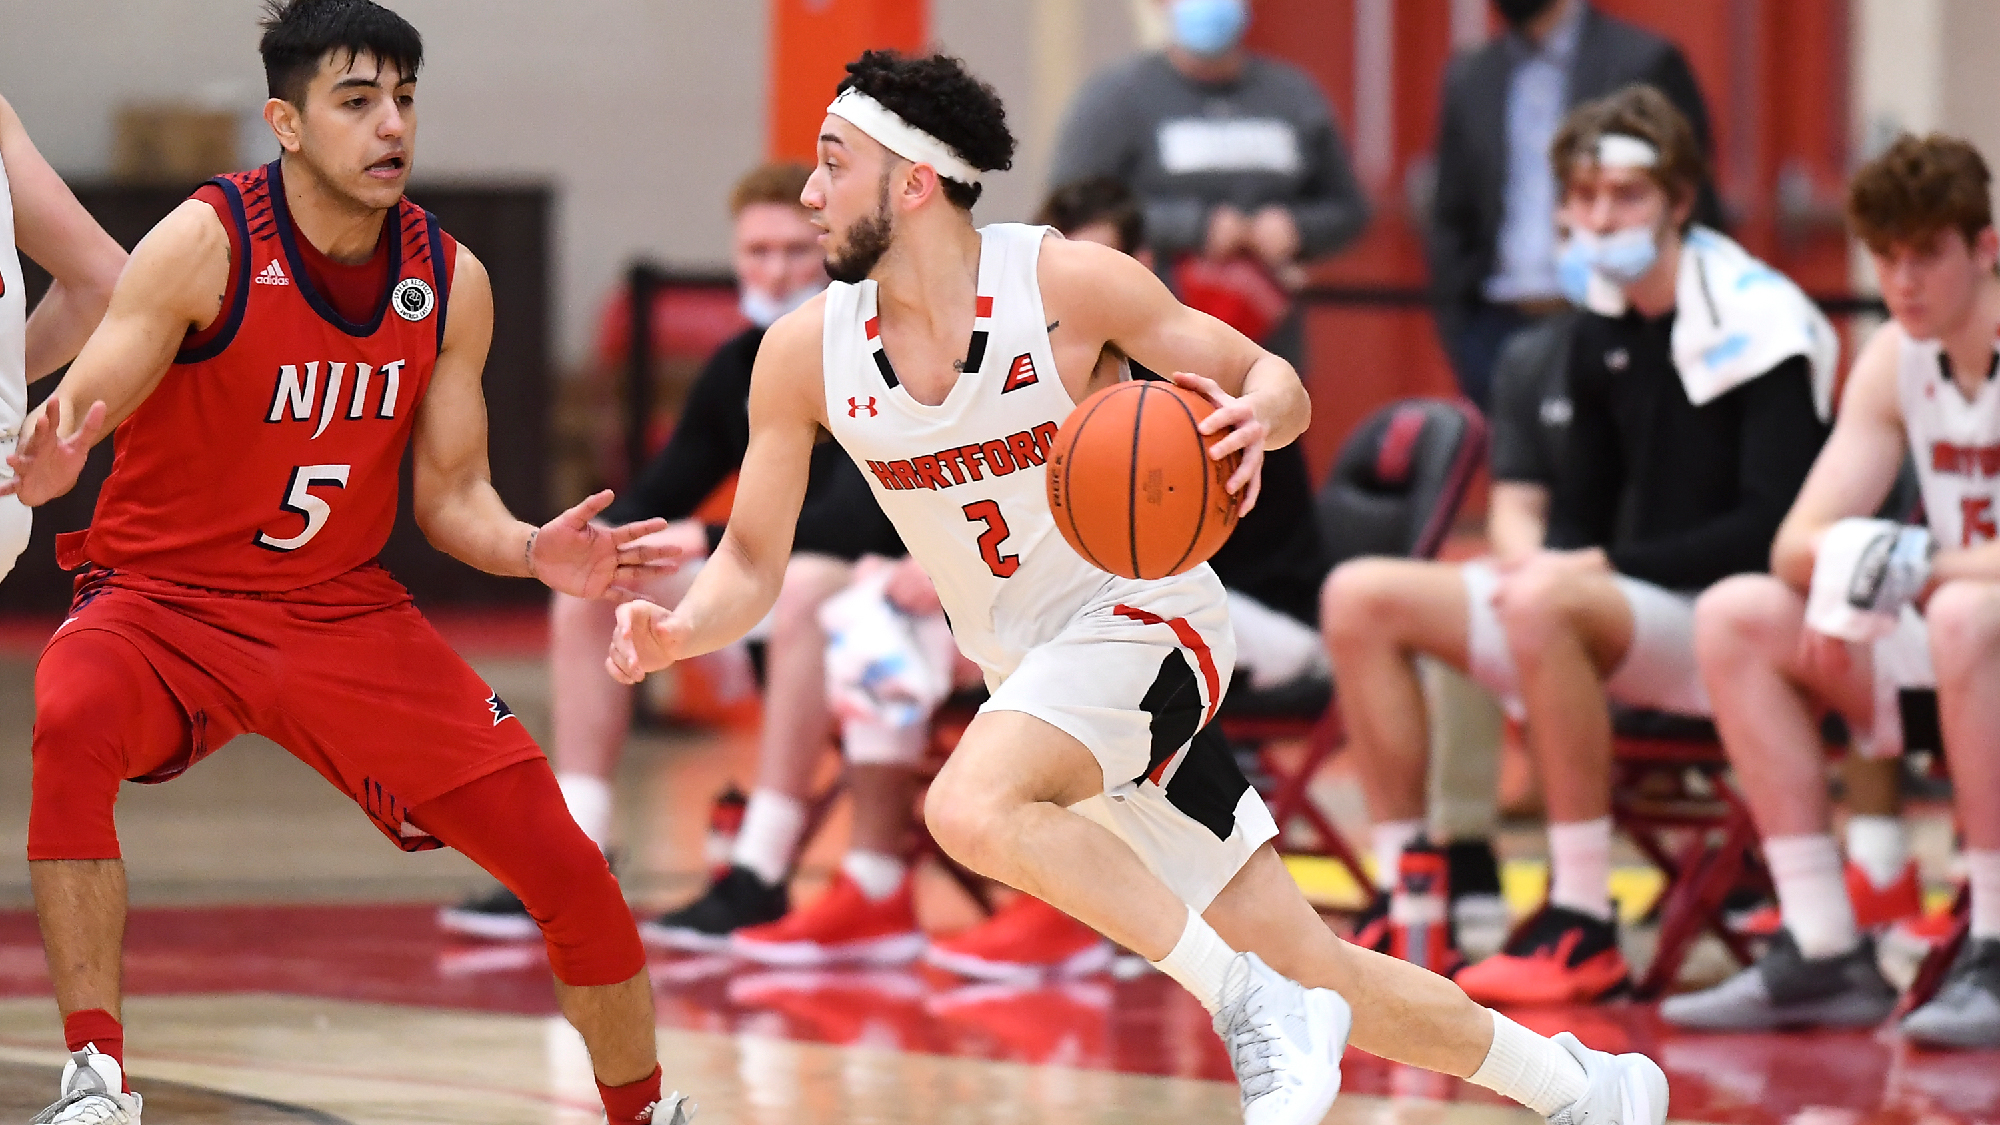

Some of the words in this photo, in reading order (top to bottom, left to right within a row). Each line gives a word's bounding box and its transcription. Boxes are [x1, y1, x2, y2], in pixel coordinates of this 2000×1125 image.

[255, 275, 290, 286] adidas
[263, 358, 406, 440] NJIT
[865, 420, 1060, 491] HARTFORD
[251, 463, 352, 553] 5
[961, 498, 1021, 579] 2
